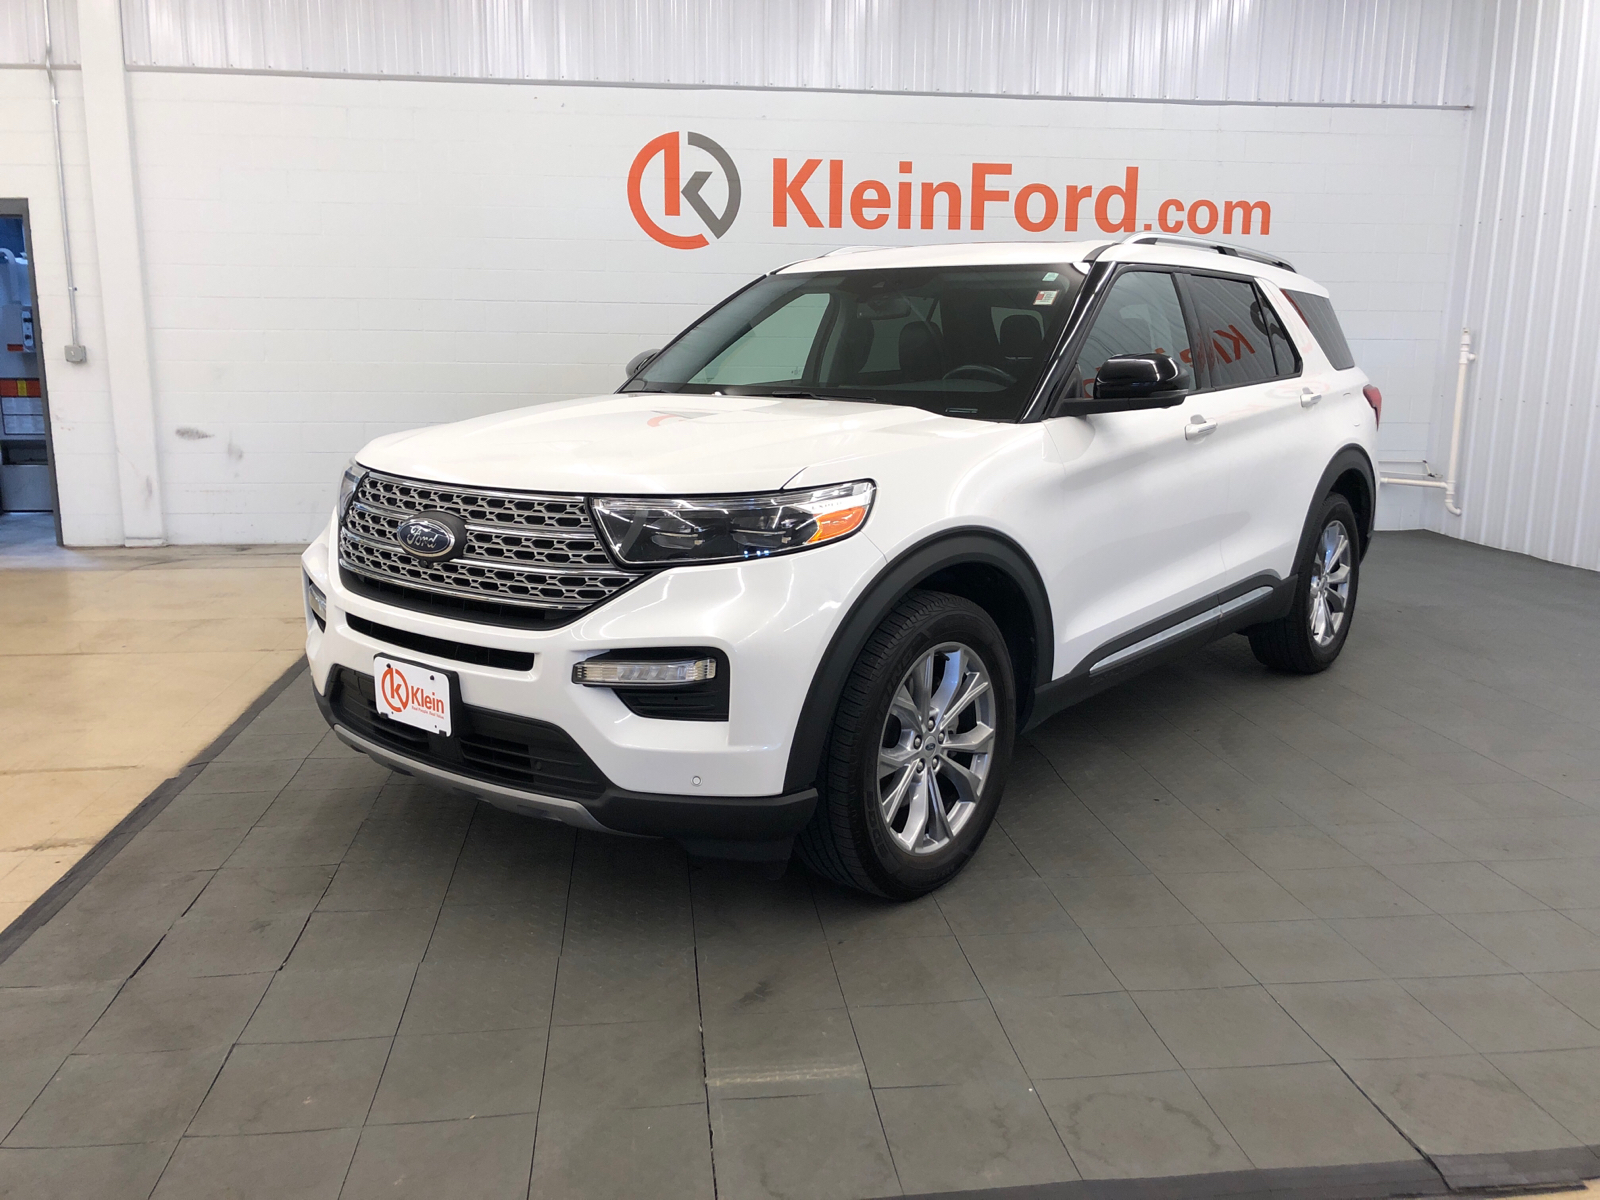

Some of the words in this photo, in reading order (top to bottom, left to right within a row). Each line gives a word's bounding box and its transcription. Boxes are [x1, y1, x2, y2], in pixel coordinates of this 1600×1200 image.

[772, 157, 1271, 236] KleinFord.com
[406, 524, 439, 549] Ford
[410, 685, 445, 714] Klein
